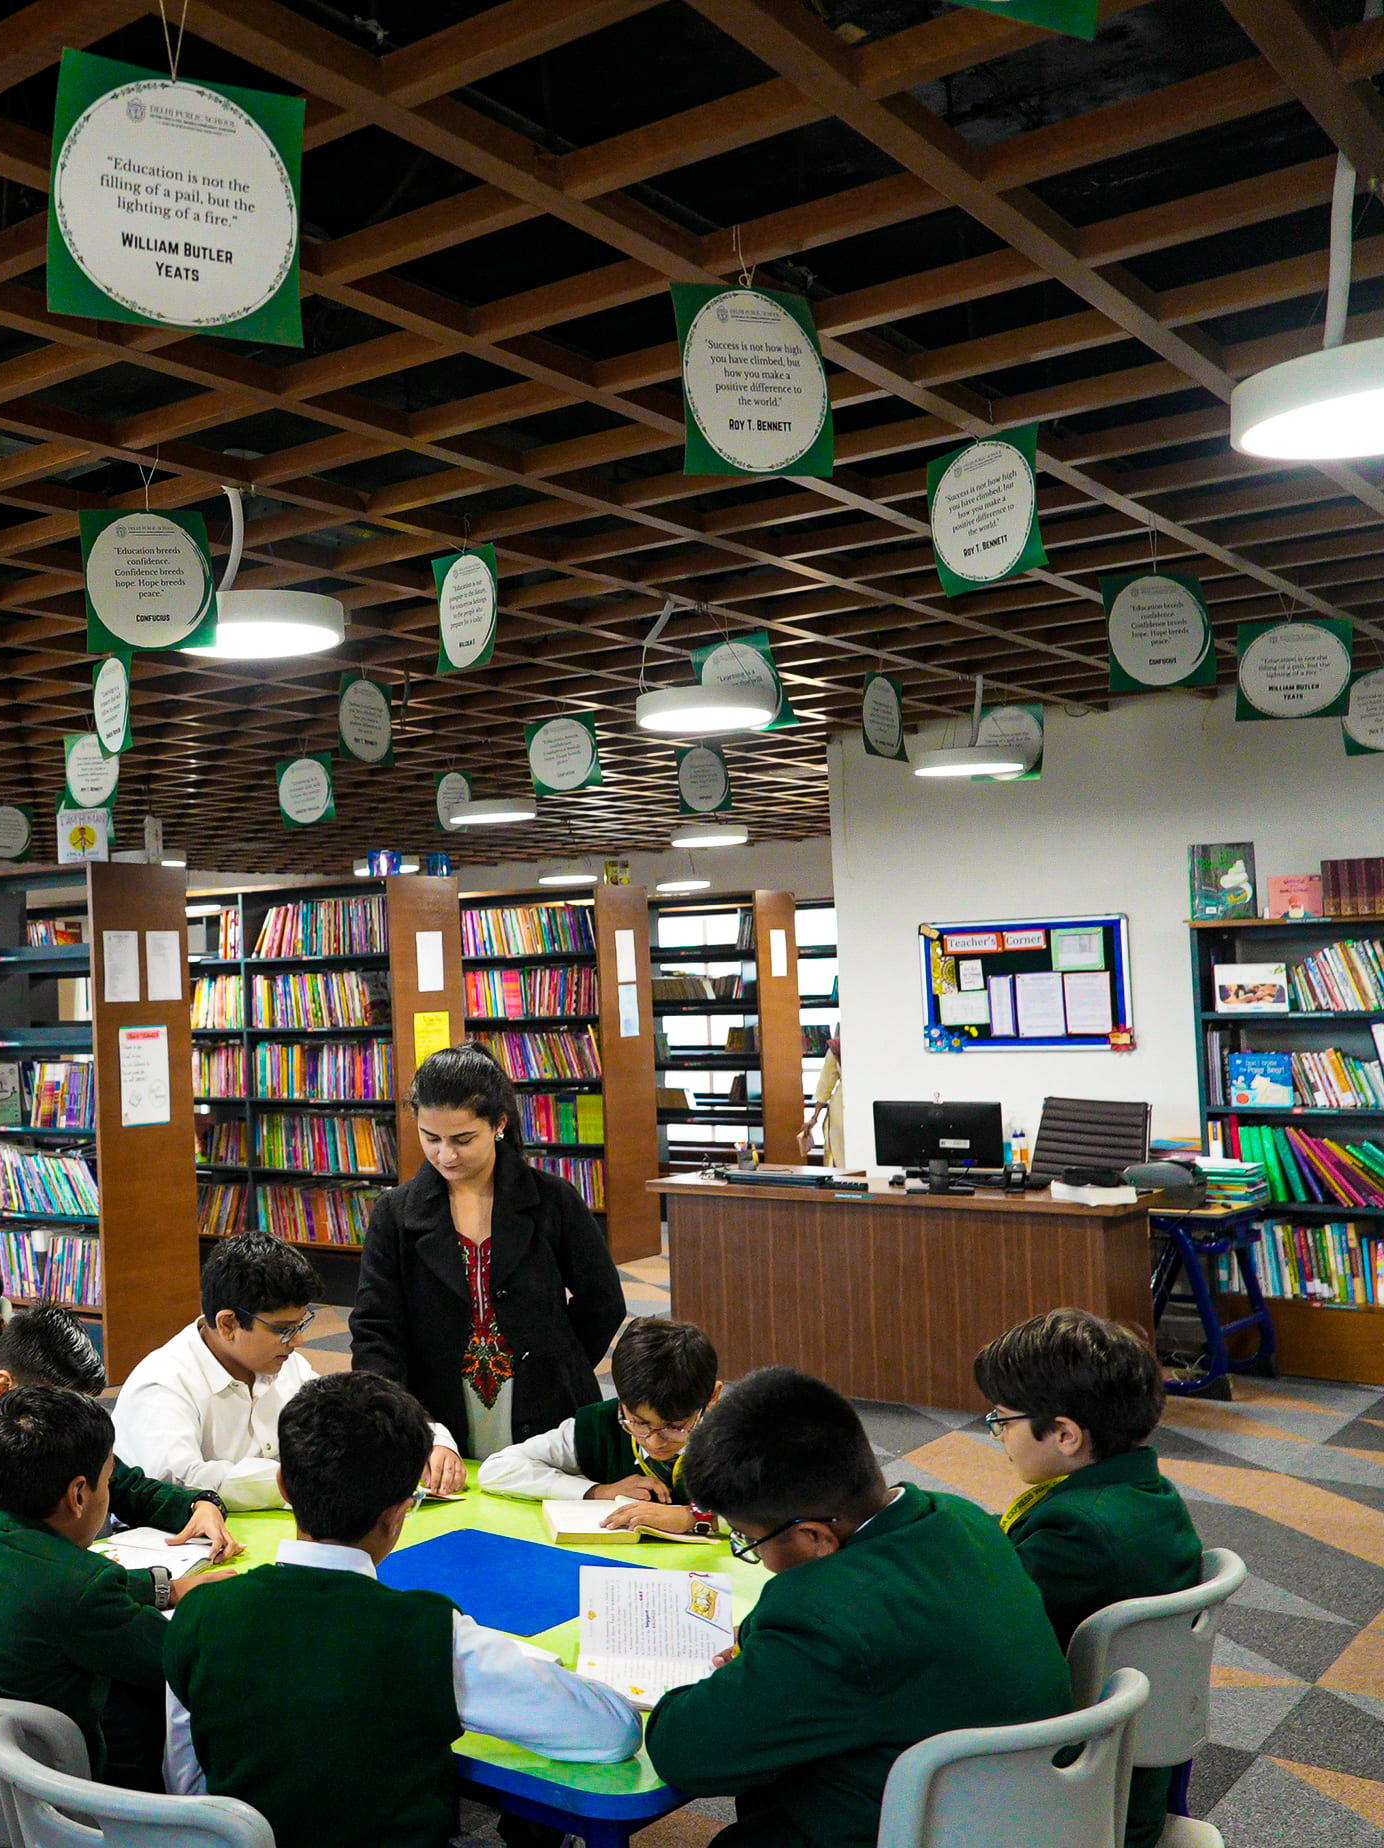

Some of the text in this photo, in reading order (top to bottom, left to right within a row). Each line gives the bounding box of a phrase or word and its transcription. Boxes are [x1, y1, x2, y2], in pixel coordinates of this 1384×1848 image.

[107, 155, 250, 194] "Education is not the
[100, 174, 256, 214] filling of a pail, but the
[117, 196, 238, 228] lighting of a fire."
[121, 231, 233, 264] WILLIAM BUTLER
[155, 261, 200, 282] YEATS
[705, 339, 802, 356] "Success is not how high
[710, 354, 800, 368] you have climbed, but
[724, 368, 742, 377] how
[744, 371, 760, 380] you
[762, 371, 784, 380] make
[716, 383, 802, 394] positive difference to
[738, 396, 752, 406] the
[729, 418, 792, 432] ROY T. BENNETT
[976, 482, 986, 490] not
[987, 477, 1001, 486] how
[1002, 469, 1017, 481] high
[949, 502, 960, 513] you
[961, 497, 975, 508] have
[1003, 482, 1014, 490] but
[958, 510, 971, 518] how
[972, 504, 983, 514] you
[984, 498, 1001, 510] make
[952, 518, 975, 533] positive
[976, 508, 1007, 523] difference
[156, 546, 181, 554] breeds
[963, 534, 1008, 557] ROY T. BENNETT
[138, 579, 160, 587] Hope
[136, 614, 170, 622] CONFUCIUS
[948, 935, 1042, 948] Teacher's Corner
